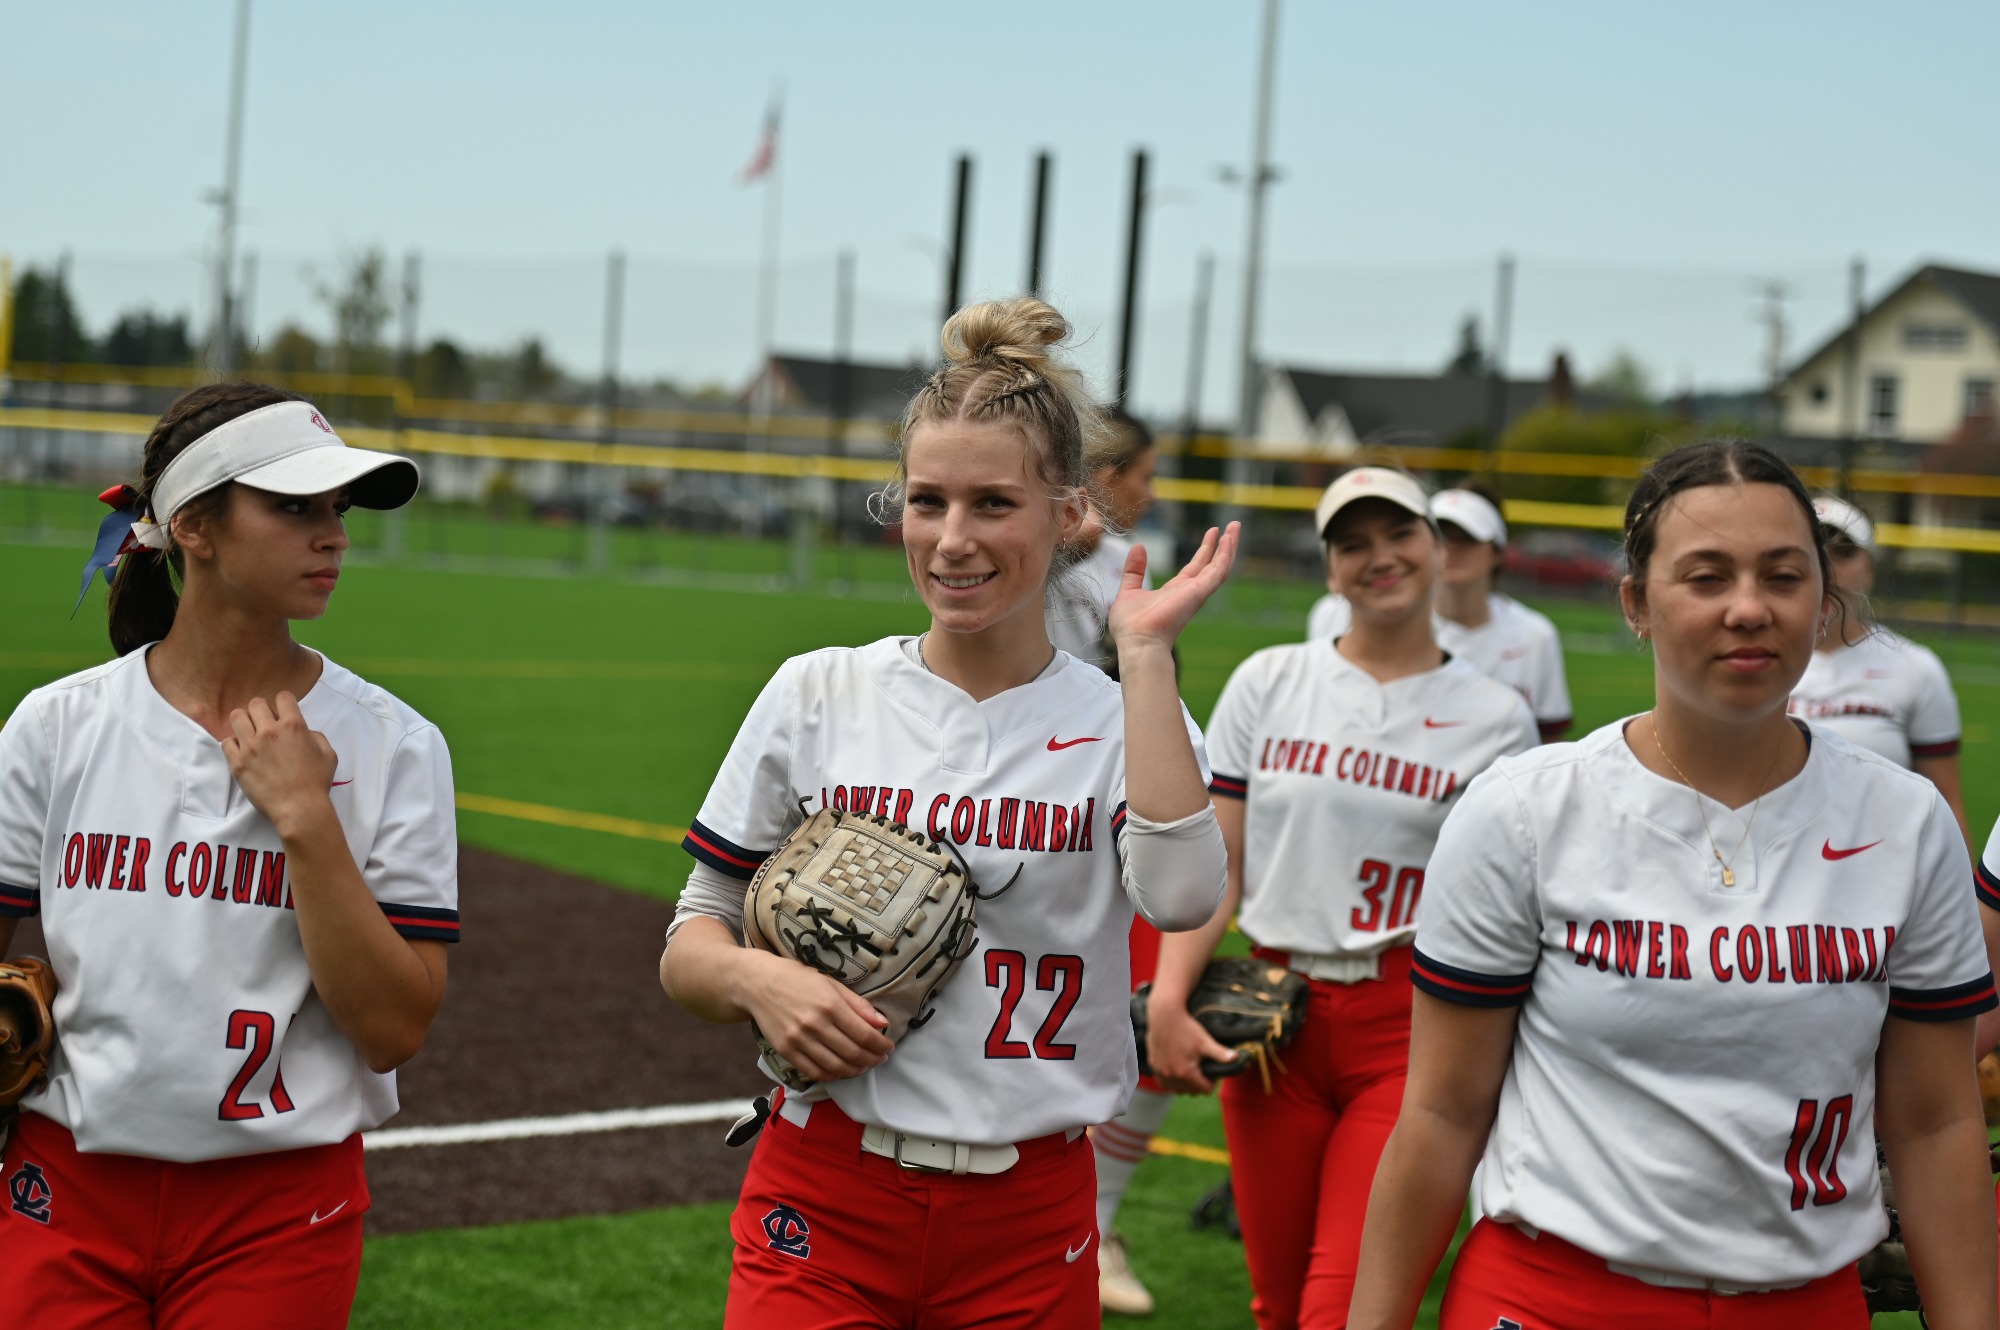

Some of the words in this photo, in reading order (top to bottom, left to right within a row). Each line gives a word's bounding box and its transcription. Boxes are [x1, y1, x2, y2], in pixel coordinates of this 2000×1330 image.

[1260, 737, 1330, 777] LOWER
[1337, 747, 1457, 800] COLUMBIA
[926, 793, 1096, 852] COLUMBIA
[57, 832, 151, 892] OWER
[165, 841, 296, 910] COLUM
[1350, 858, 1426, 933] 30
[1565, 919, 1692, 981] LOWER
[984, 948, 1085, 1061] 22
[1784, 1093, 1854, 1213] 10
